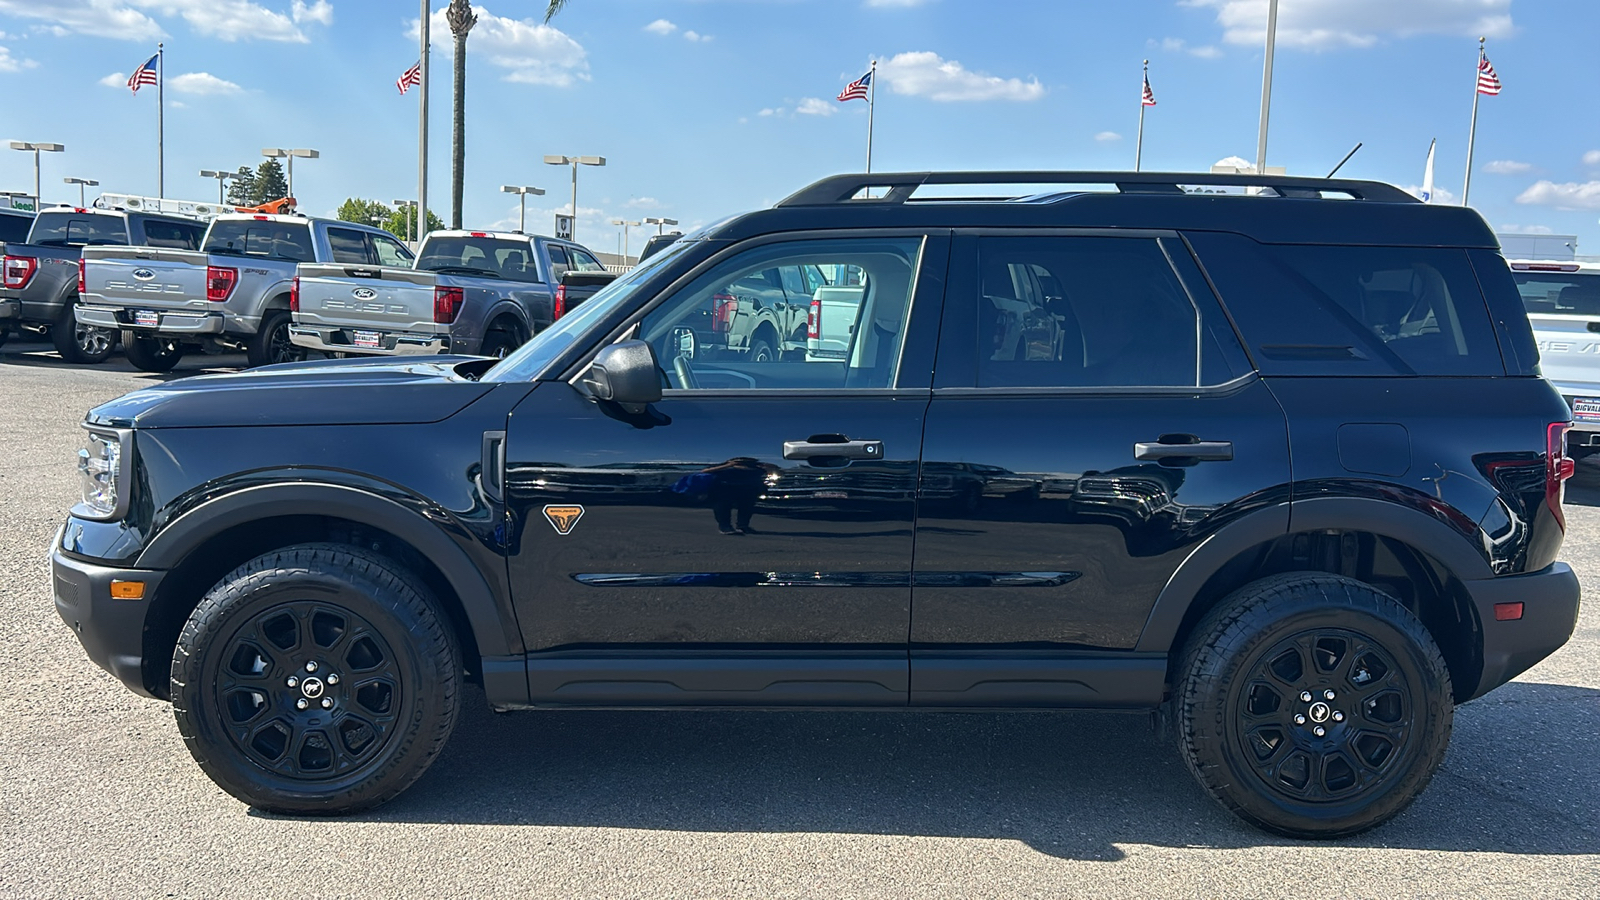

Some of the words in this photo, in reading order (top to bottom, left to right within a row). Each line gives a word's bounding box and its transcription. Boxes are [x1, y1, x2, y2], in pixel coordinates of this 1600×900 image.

[12, 200, 34, 212] Jeep
[557, 231, 571, 239] RAM
[105, 280, 185, 294] F-150
[320, 299, 410, 316] F-150
